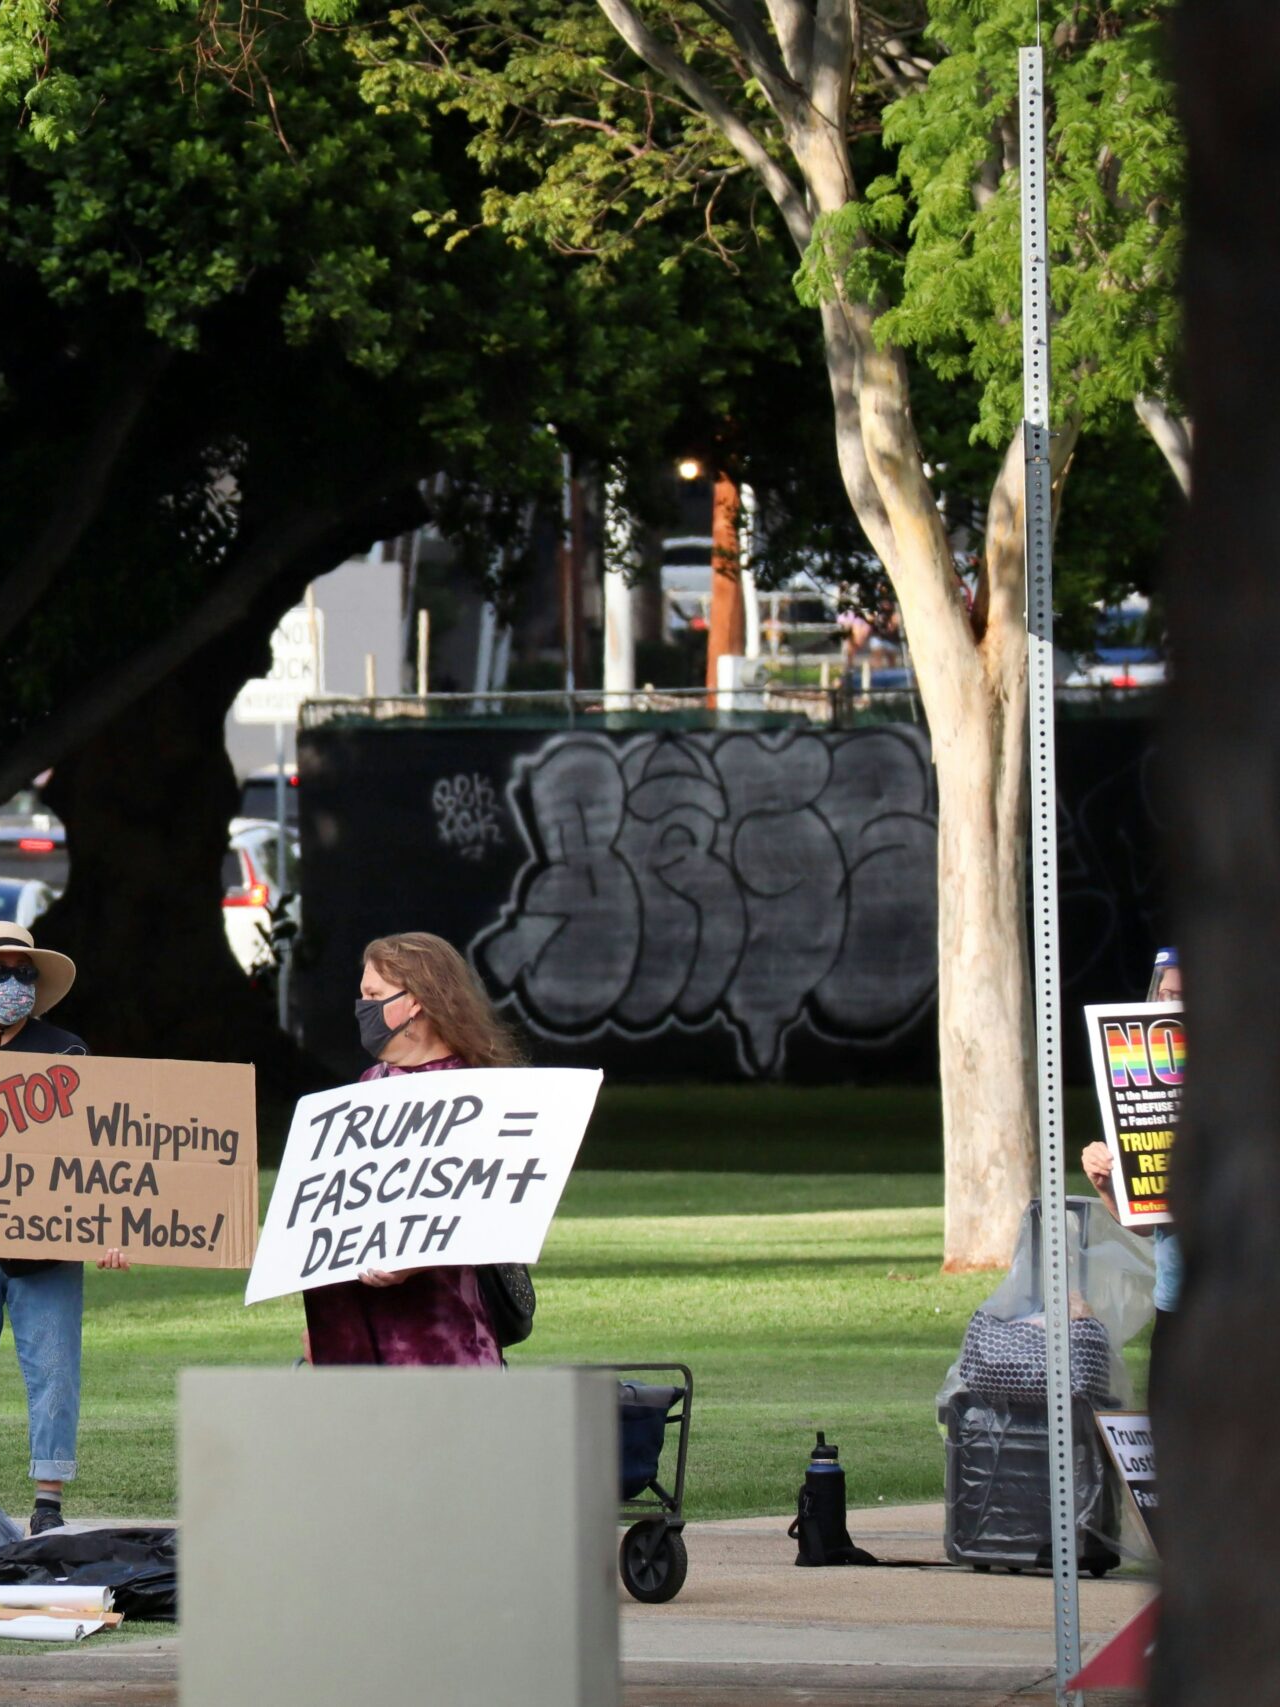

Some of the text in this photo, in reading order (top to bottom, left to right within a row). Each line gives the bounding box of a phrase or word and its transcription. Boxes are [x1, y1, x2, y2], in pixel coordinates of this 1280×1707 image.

[1126, 1090, 1141, 1101] the
[1117, 1103, 1134, 1114] We
[1136, 1101, 1174, 1113] REFUSE
[310, 1095, 483, 1161] TRUMP
[1120, 1117, 1128, 1127] a
[1129, 1115, 1167, 1126] Fascist
[86, 1102, 239, 1165] Whipping
[49, 1157, 159, 1197] MAGA
[1133, 1202, 1168, 1213] Refus
[121, 1207, 224, 1251] Mobs!
[300, 1214, 461, 1278] DEATH
[1107, 1426, 1152, 1446] Trum
[1133, 1489, 1159, 1508] Fas
